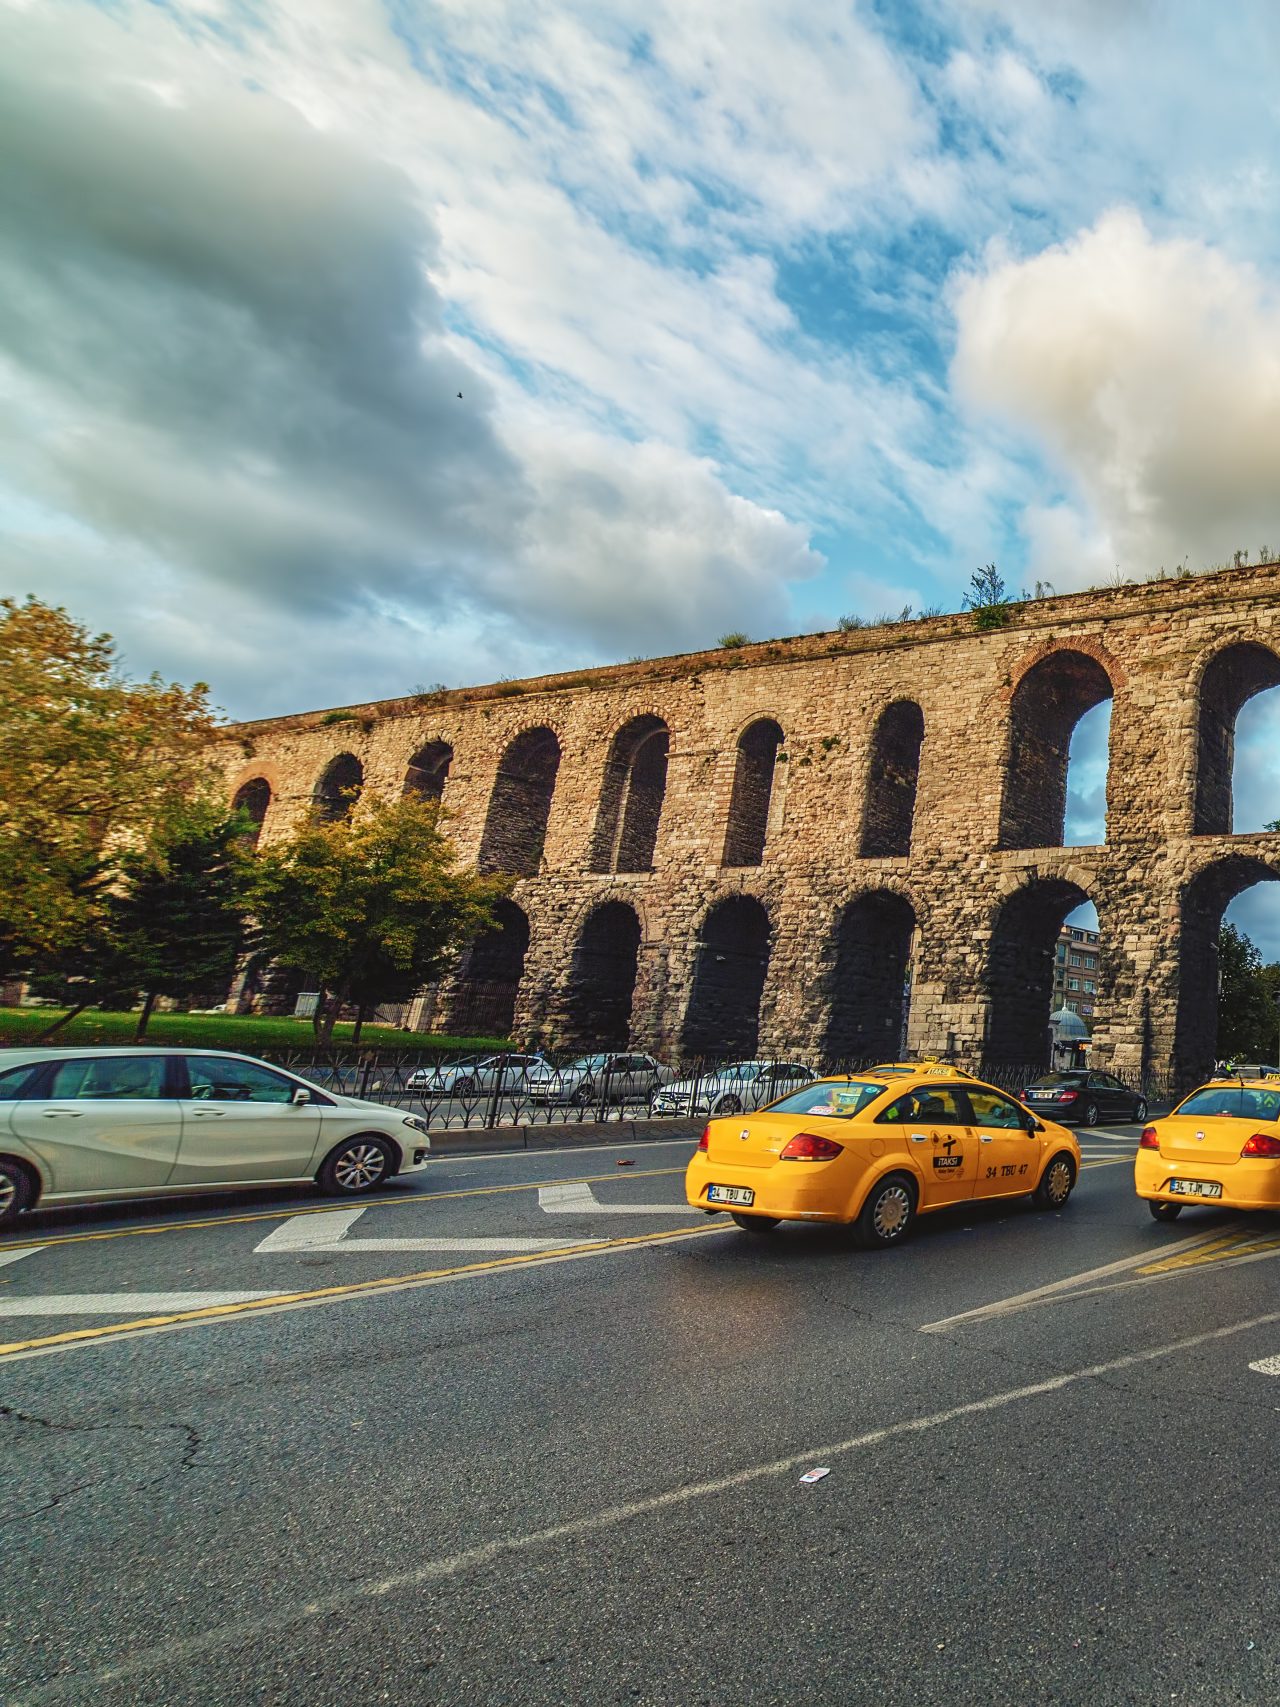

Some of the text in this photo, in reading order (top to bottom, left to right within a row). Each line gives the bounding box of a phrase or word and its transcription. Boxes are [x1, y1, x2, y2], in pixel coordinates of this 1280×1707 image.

[985, 1164, 1029, 1178] 34 TBU 47
[712, 1187, 752, 1201] 34 TBU 47
[1175, 1181, 1184, 1191] 34
[1189, 1183, 1203, 1193] TJM
[1209, 1184, 1220, 1195] 77
